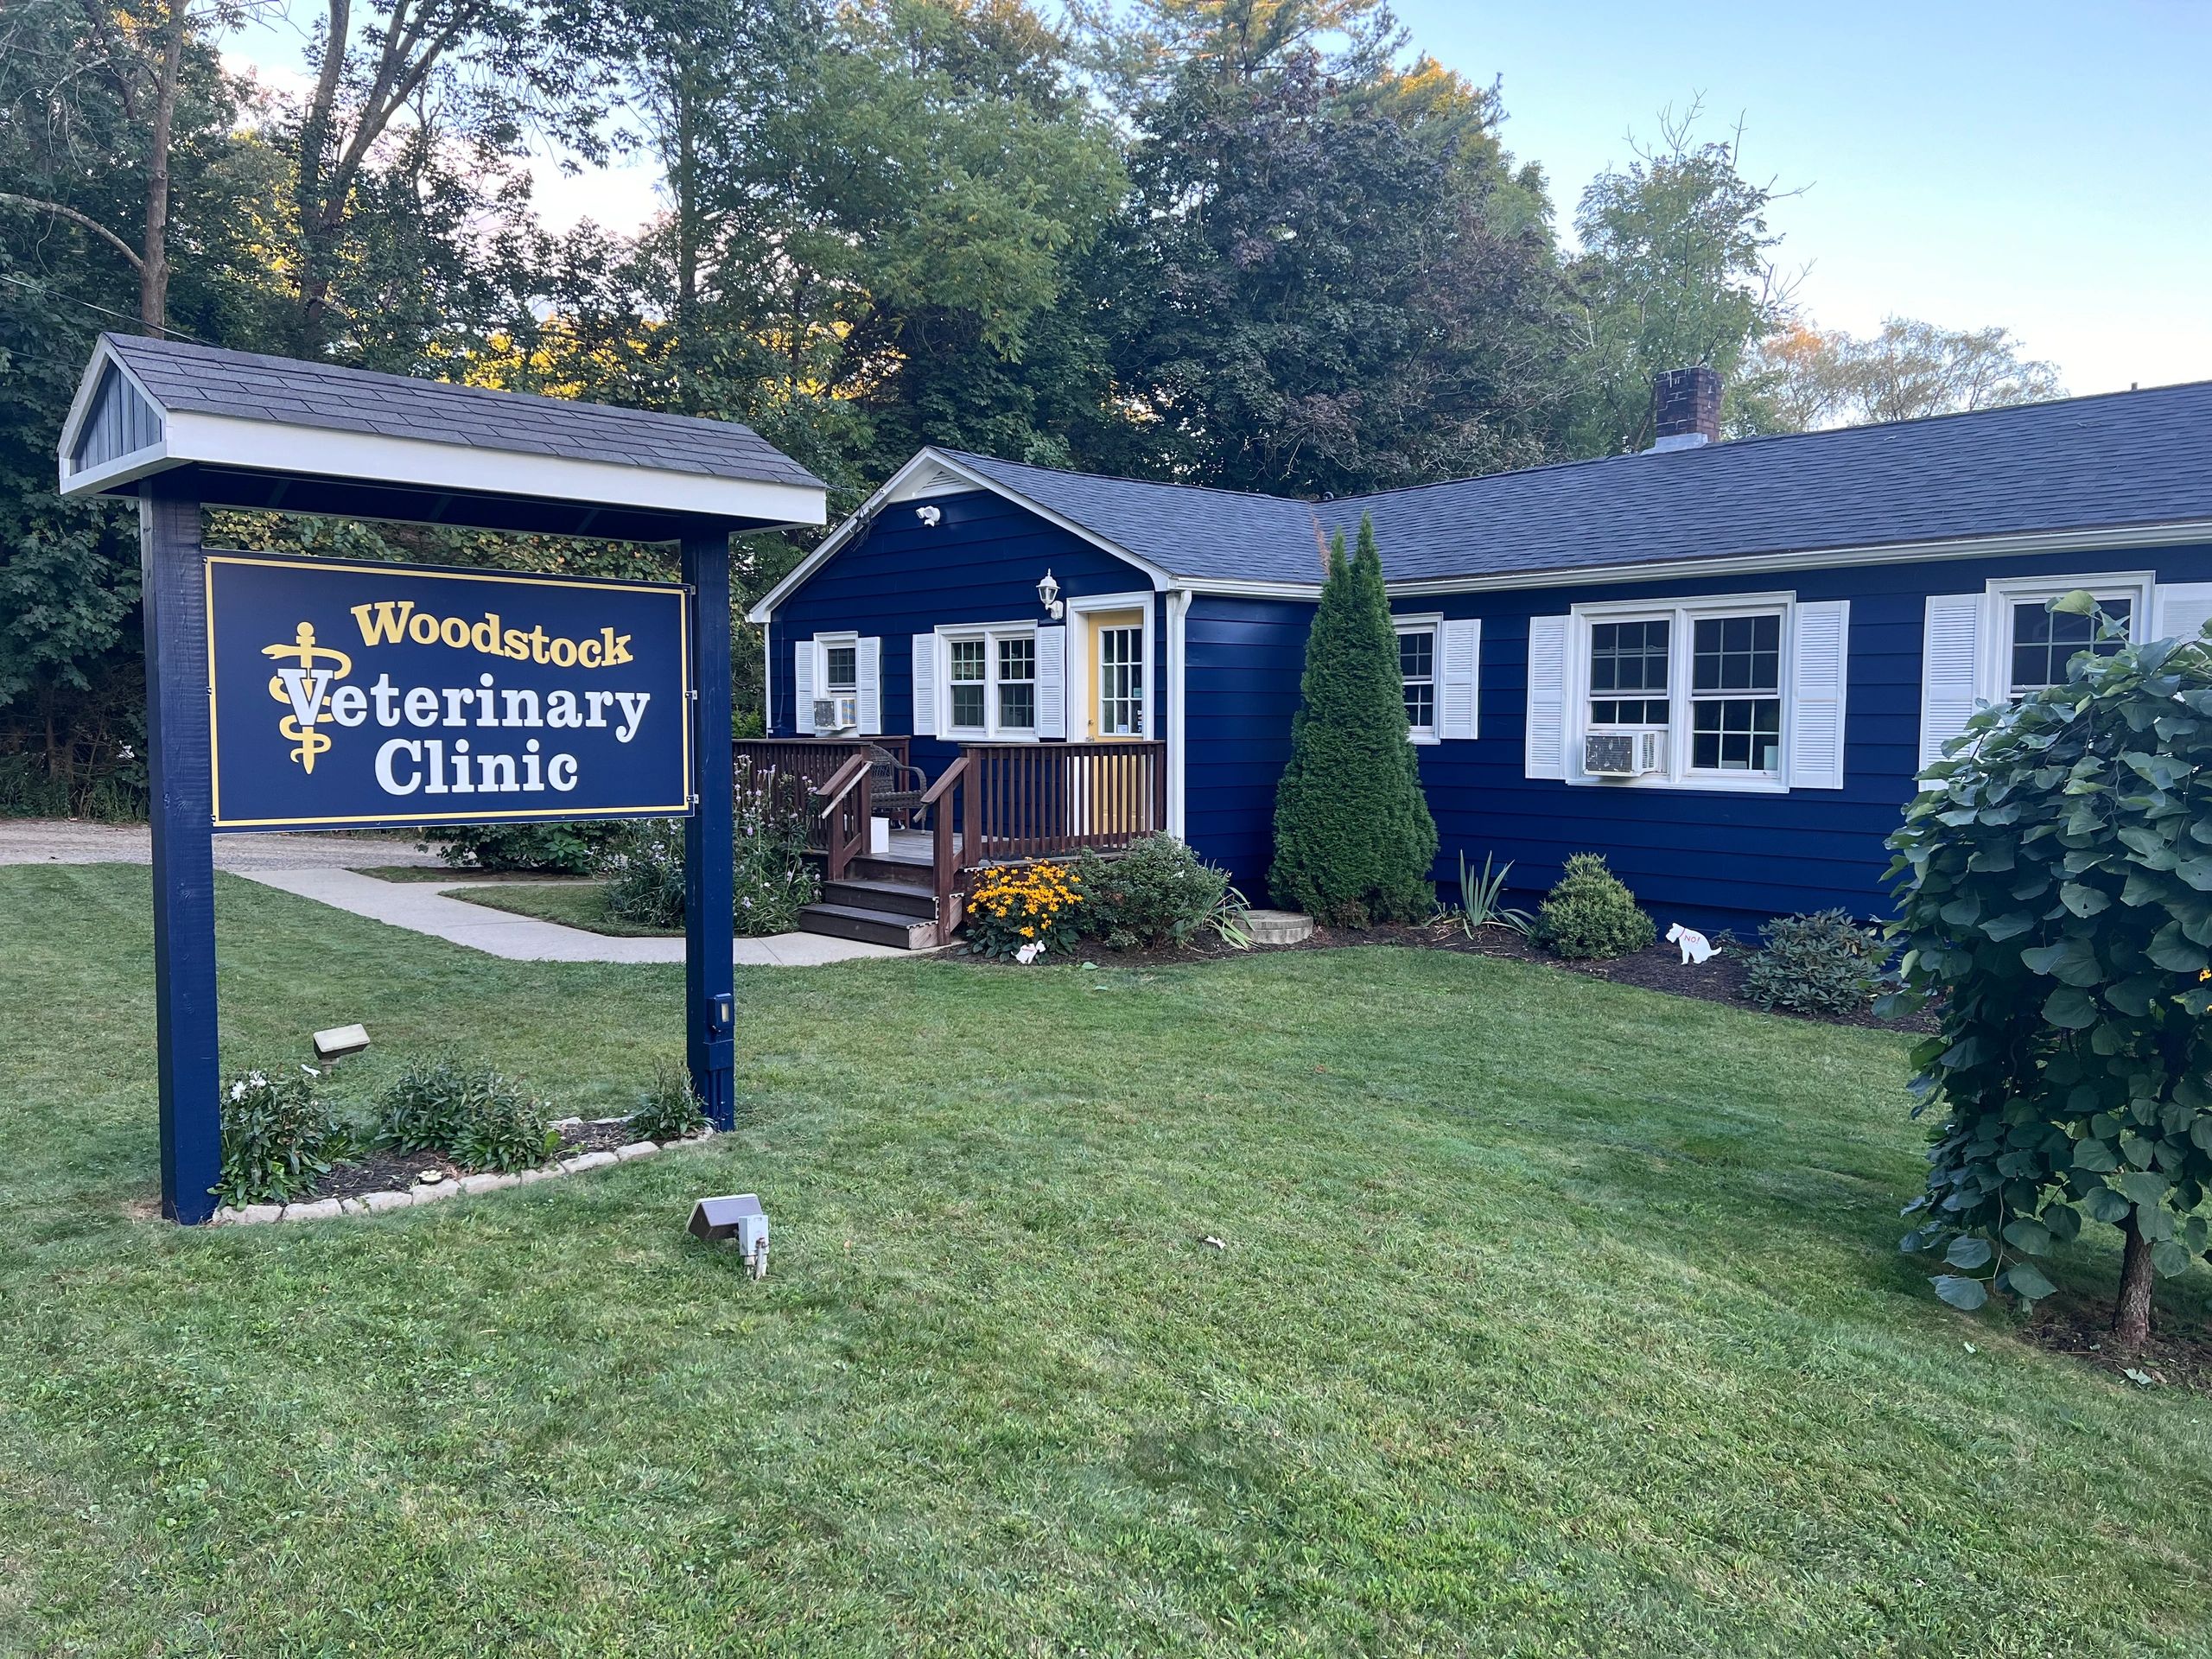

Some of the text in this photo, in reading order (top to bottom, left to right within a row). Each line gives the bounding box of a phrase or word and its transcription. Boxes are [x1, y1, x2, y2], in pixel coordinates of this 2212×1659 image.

[351, 601, 633, 669] Woodstock
[276, 668, 651, 743] Veterinary
[374, 738, 578, 796] Clinic
[1683, 934, 1701, 944] NO!
